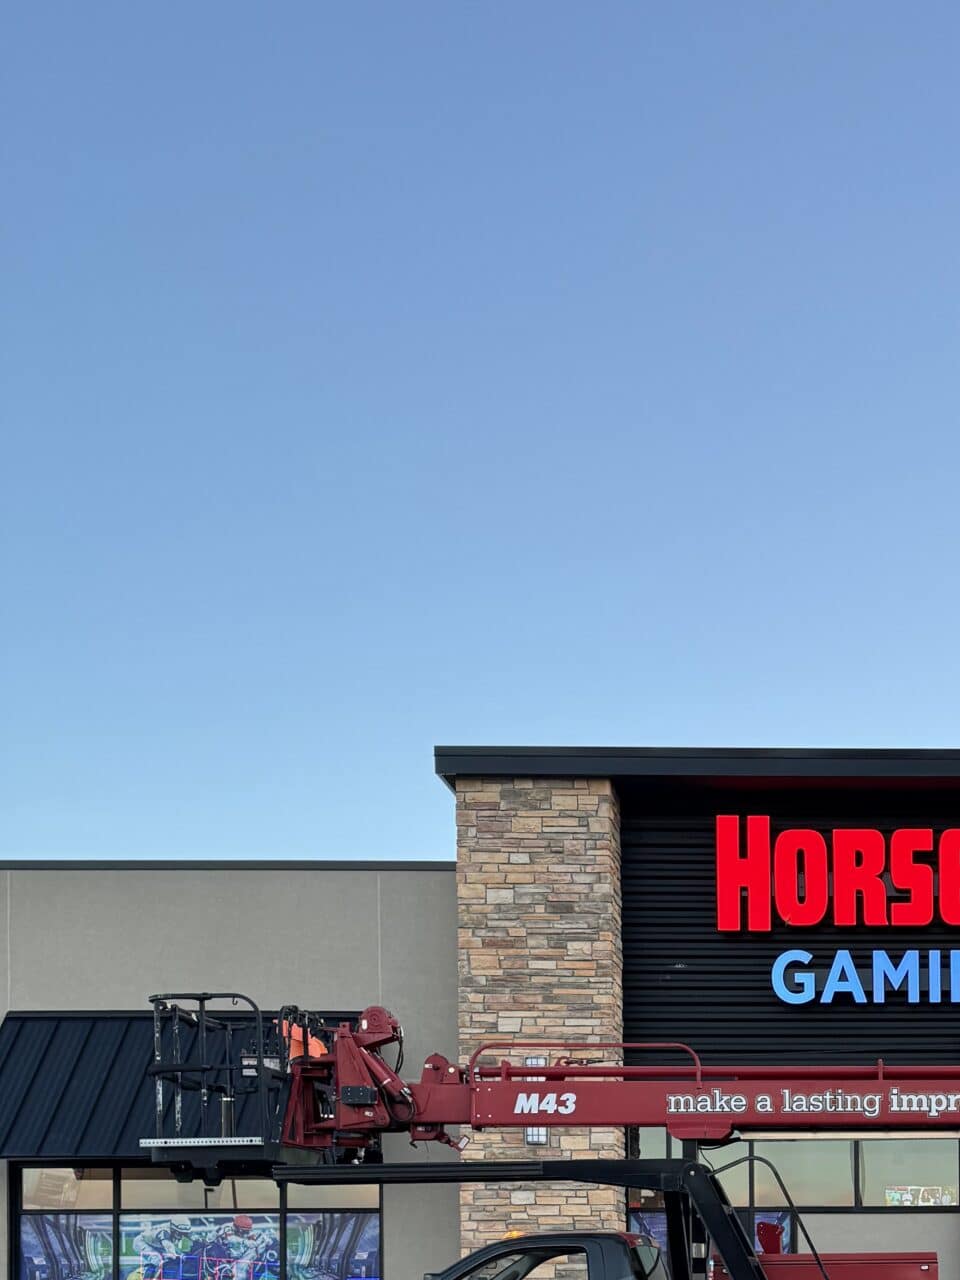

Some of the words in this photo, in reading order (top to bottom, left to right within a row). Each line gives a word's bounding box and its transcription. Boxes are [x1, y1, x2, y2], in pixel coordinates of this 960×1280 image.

[513, 1093, 577, 1115] M43
[667, 1089, 747, 1113] make
[755, 1095, 773, 1113] a
[781, 1089, 881, 1117] lasting
